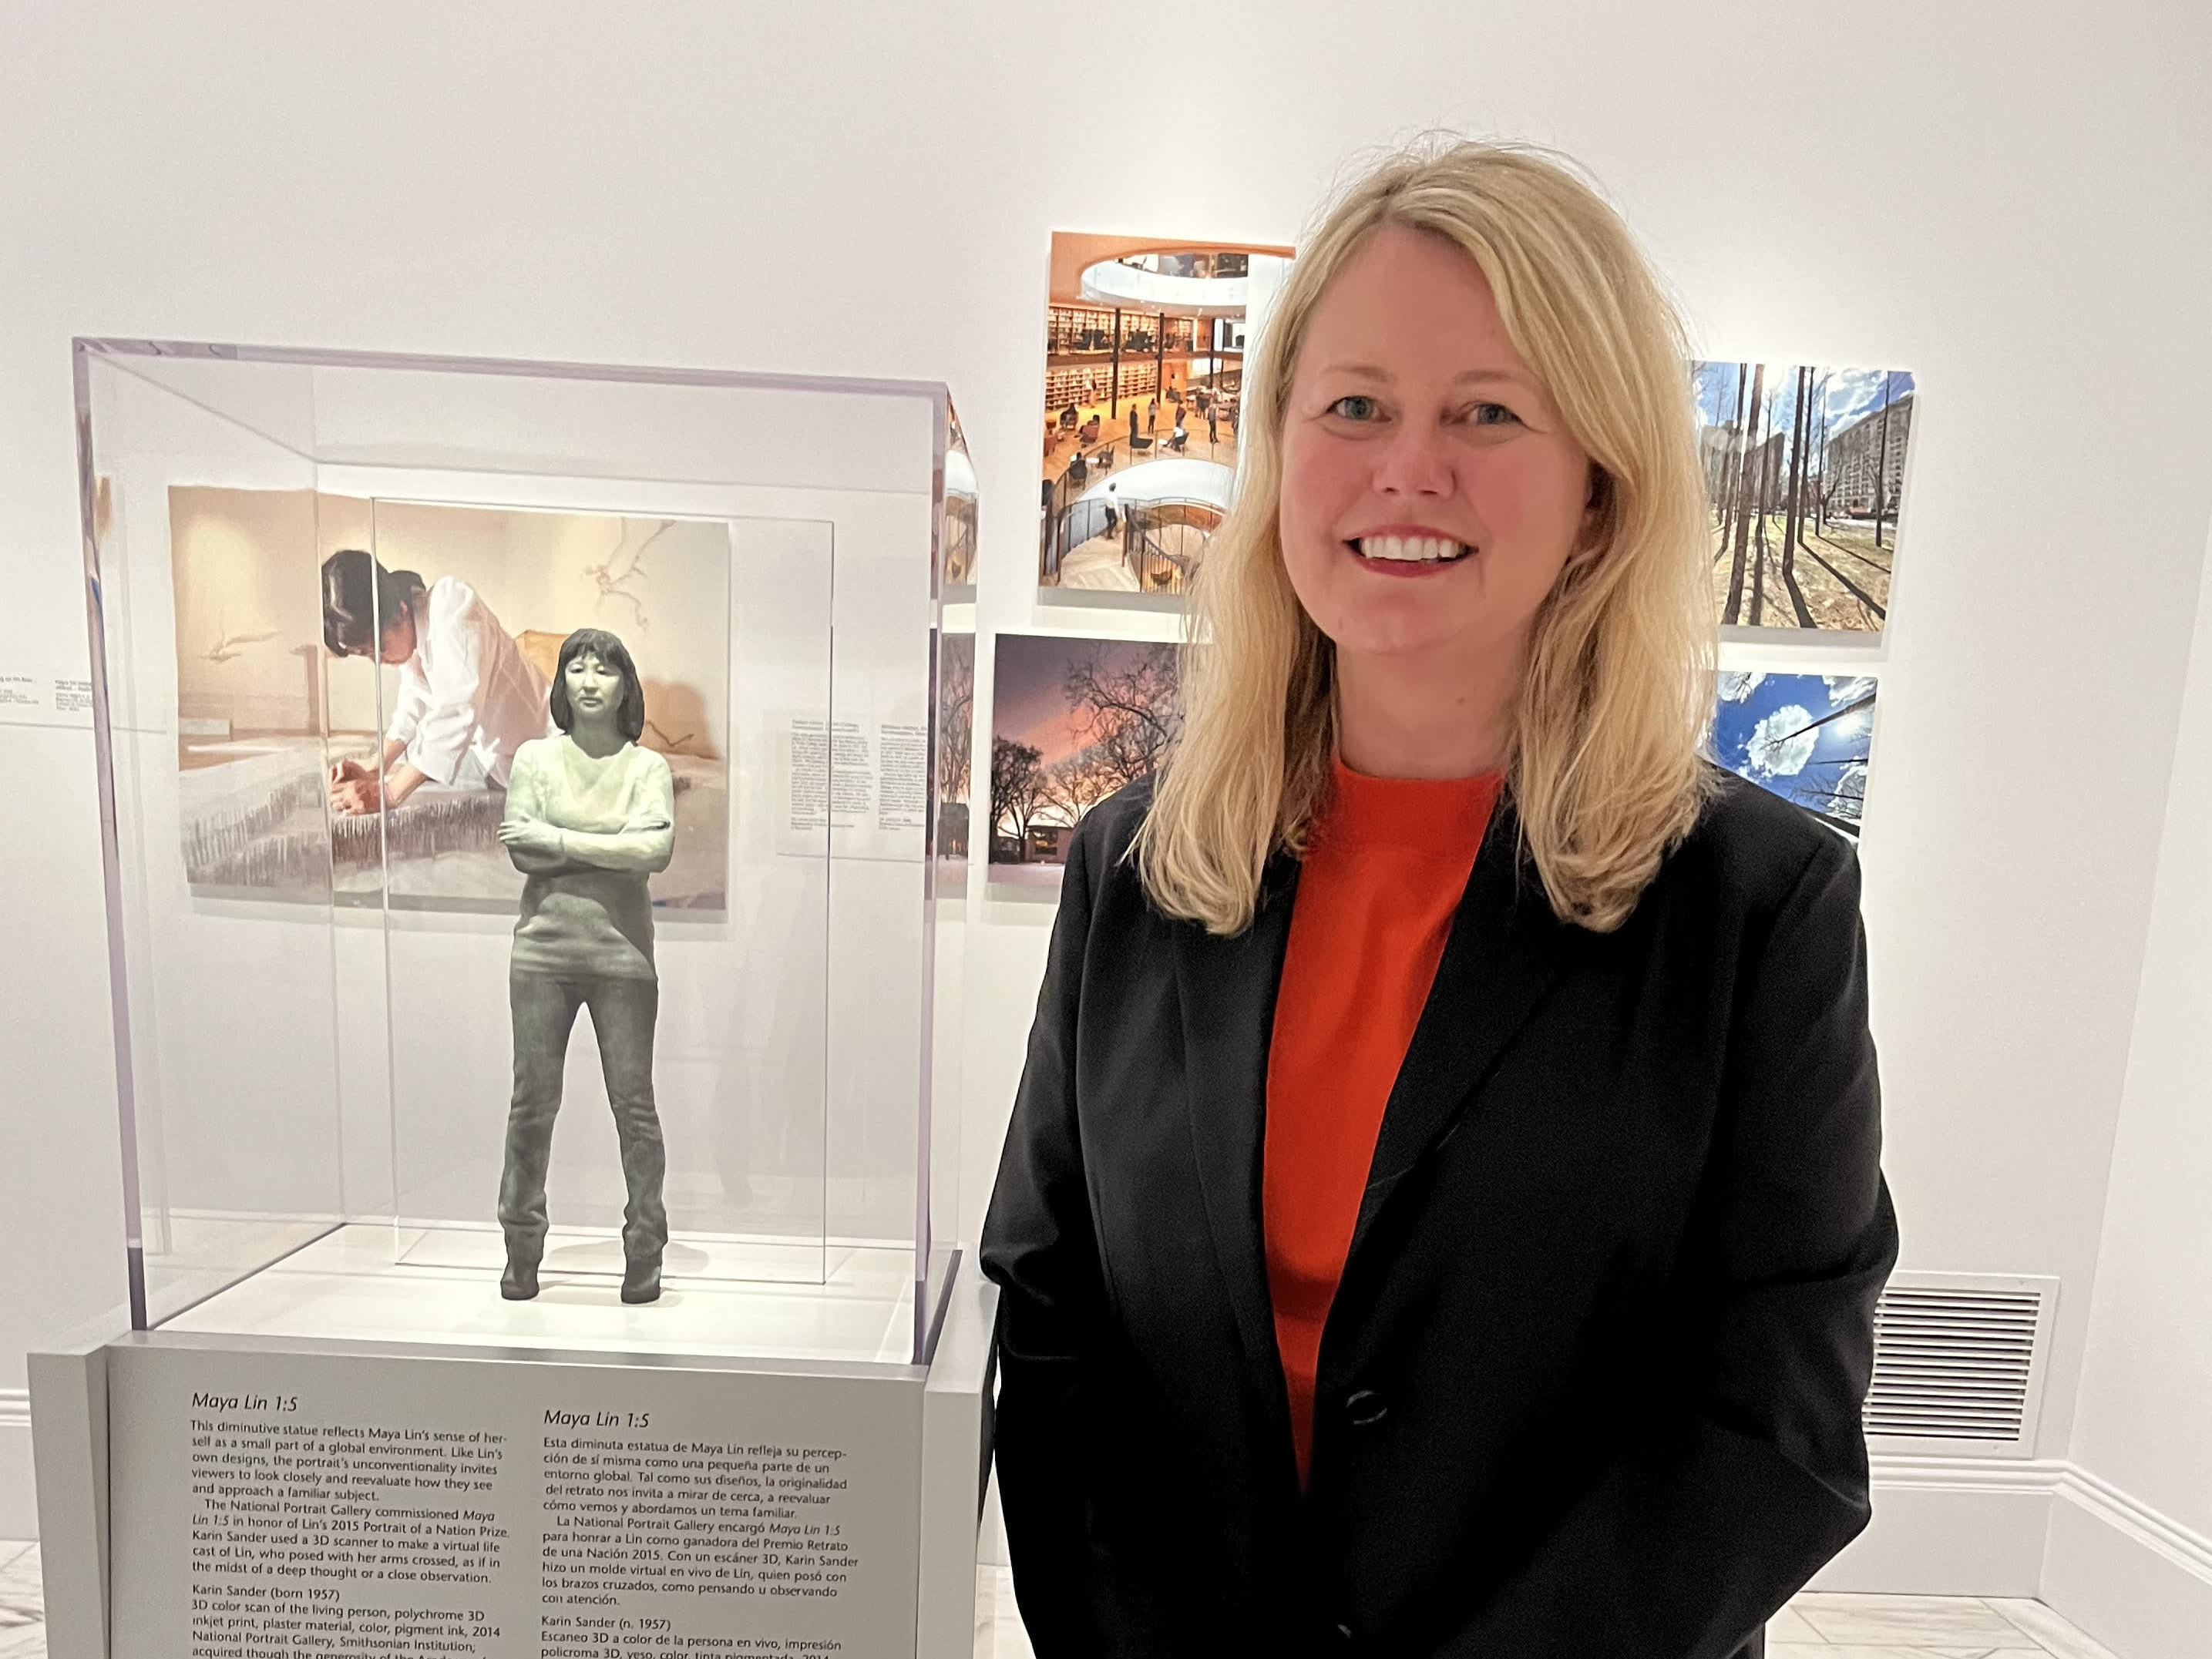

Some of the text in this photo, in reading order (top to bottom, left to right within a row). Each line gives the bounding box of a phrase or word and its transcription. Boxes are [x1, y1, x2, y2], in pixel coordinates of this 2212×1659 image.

[192, 1392, 298, 1413] Maya Lin 1:5
[544, 1409, 649, 1429] Maya Lin 1:5
[190, 1419, 506, 1443] This diminutive statue reflects Maya Lin's sense of her-
[193, 1435, 210, 1446] self
[214, 1439, 227, 1447] as
[241, 1437, 271, 1449] small
[275, 1440, 298, 1453] part
[303, 1439, 314, 1451] of
[328, 1441, 365, 1456] global
[368, 1443, 446, 1457] environment.
[452, 1446, 473, 1458] Like
[478, 1448, 502, 1459] Lin's
[543, 1437, 566, 1448] Esta
[570, 1438, 623, 1449] diminuta
[627, 1441, 668, 1452] estatua
[672, 1442, 687, 1452] de
[691, 1442, 722, 1456] Maya
[728, 1444, 743, 1454] Lin
[748, 1445, 782, 1459] refleja
[802, 1449, 846, 1461] percep-
[193, 1452, 497, 1476] own designs, the portrait's unconventionality invites
[543, 1452, 568, 1463] ción
[572, 1453, 587, 1464] de
[590, 1453, 600, 1465] sí
[603, 1456, 640, 1466] misma
[644, 1459, 677, 1468] como
[682, 1460, 703, 1469] una
[708, 1459, 758, 1473] pequeña
[762, 1462, 792, 1474] parte
[796, 1462, 810, 1473] de
[191, 1467, 492, 1492] viewers to look closely and reevaluate how they see
[544, 1469, 589, 1479] entorno
[637, 1471, 653, 1482] Tal
[657, 1475, 690, 1483] como
[694, 1476, 711, 1484] sus
[715, 1474, 761, 1487] diseños,
[765, 1476, 775, 1486] la
[778, 1476, 846, 1493] originalidad
[193, 1482, 378, 1503] and approach a familiar subject.
[204, 1498, 495, 1524] The National Portrait Gallery commissioned Maya
[193, 1513, 208, 1525] Lin
[233, 1515, 244, 1526] in
[248, 1516, 282, 1528] honor
[287, 1517, 298, 1529] of
[302, 1518, 327, 1530] Lin's
[331, 1520, 358, 1531] 2015
[364, 1521, 405, 1533] Portrait
[410, 1523, 422, 1533] of
[425, 1526, 432, 1534] a
[436, 1524, 475, 1536] Nation
[556, 1515, 570, 1526] La
[573, 1516, 623, 1528] National
[627, 1518, 669, 1530] Portrait
[674, 1519, 714, 1534] Gallery
[718, 1520, 765, 1536] encargó
[769, 1523, 800, 1536] Maya
[804, 1525, 820, 1535] Lin
[543, 1533, 568, 1544] para
[572, 1531, 610, 1543] honrar
[626, 1533, 642, 1543] Lin
[646, 1536, 679, 1545] como
[683, 1535, 738, 1550] ganadora
[741, 1537, 759, 1548] del
[763, 1538, 803, 1550] Premio
[808, 1540, 848, 1551] Retrato
[543, 1546, 556, 1557] de
[561, 1549, 582, 1557] una
[587, 1546, 627, 1559] Nación
[632, 1549, 663, 1560] 2015.
[667, 1548, 691, 1561] Con
[714, 1552, 758, 1563] escáner
[762, 1553, 780, 1566] 3D,
[785, 1554, 815, 1565] Karin
[819, 1555, 858, 1567] Sander
[193, 1583, 339, 1602] Karin Sander (born 1957)
[542, 1577, 557, 1587] los
[561, 1577, 598, 1589] brazos
[603, 1579, 657, 1592] cruzados,
[661, 1583, 694, 1592] como
[698, 1582, 755, 1597] pensando
[770, 1584, 837, 1597] observando
[192, 1599, 484, 1624] 3D color scan of the living person, polychrome 3D
[541, 1615, 570, 1626] Karin
[576, 1616, 615, 1627] Sander
[640, 1618, 671, 1631] 1957)
[193, 1630, 241, 1643] National
[245, 1632, 288, 1644] Portrait
[291, 1634, 334, 1649] Gallery,
[340, 1636, 410, 1649] Smithsonian
[192, 1647, 243, 1659] acquired
[540, 1647, 592, 1659] policroma
